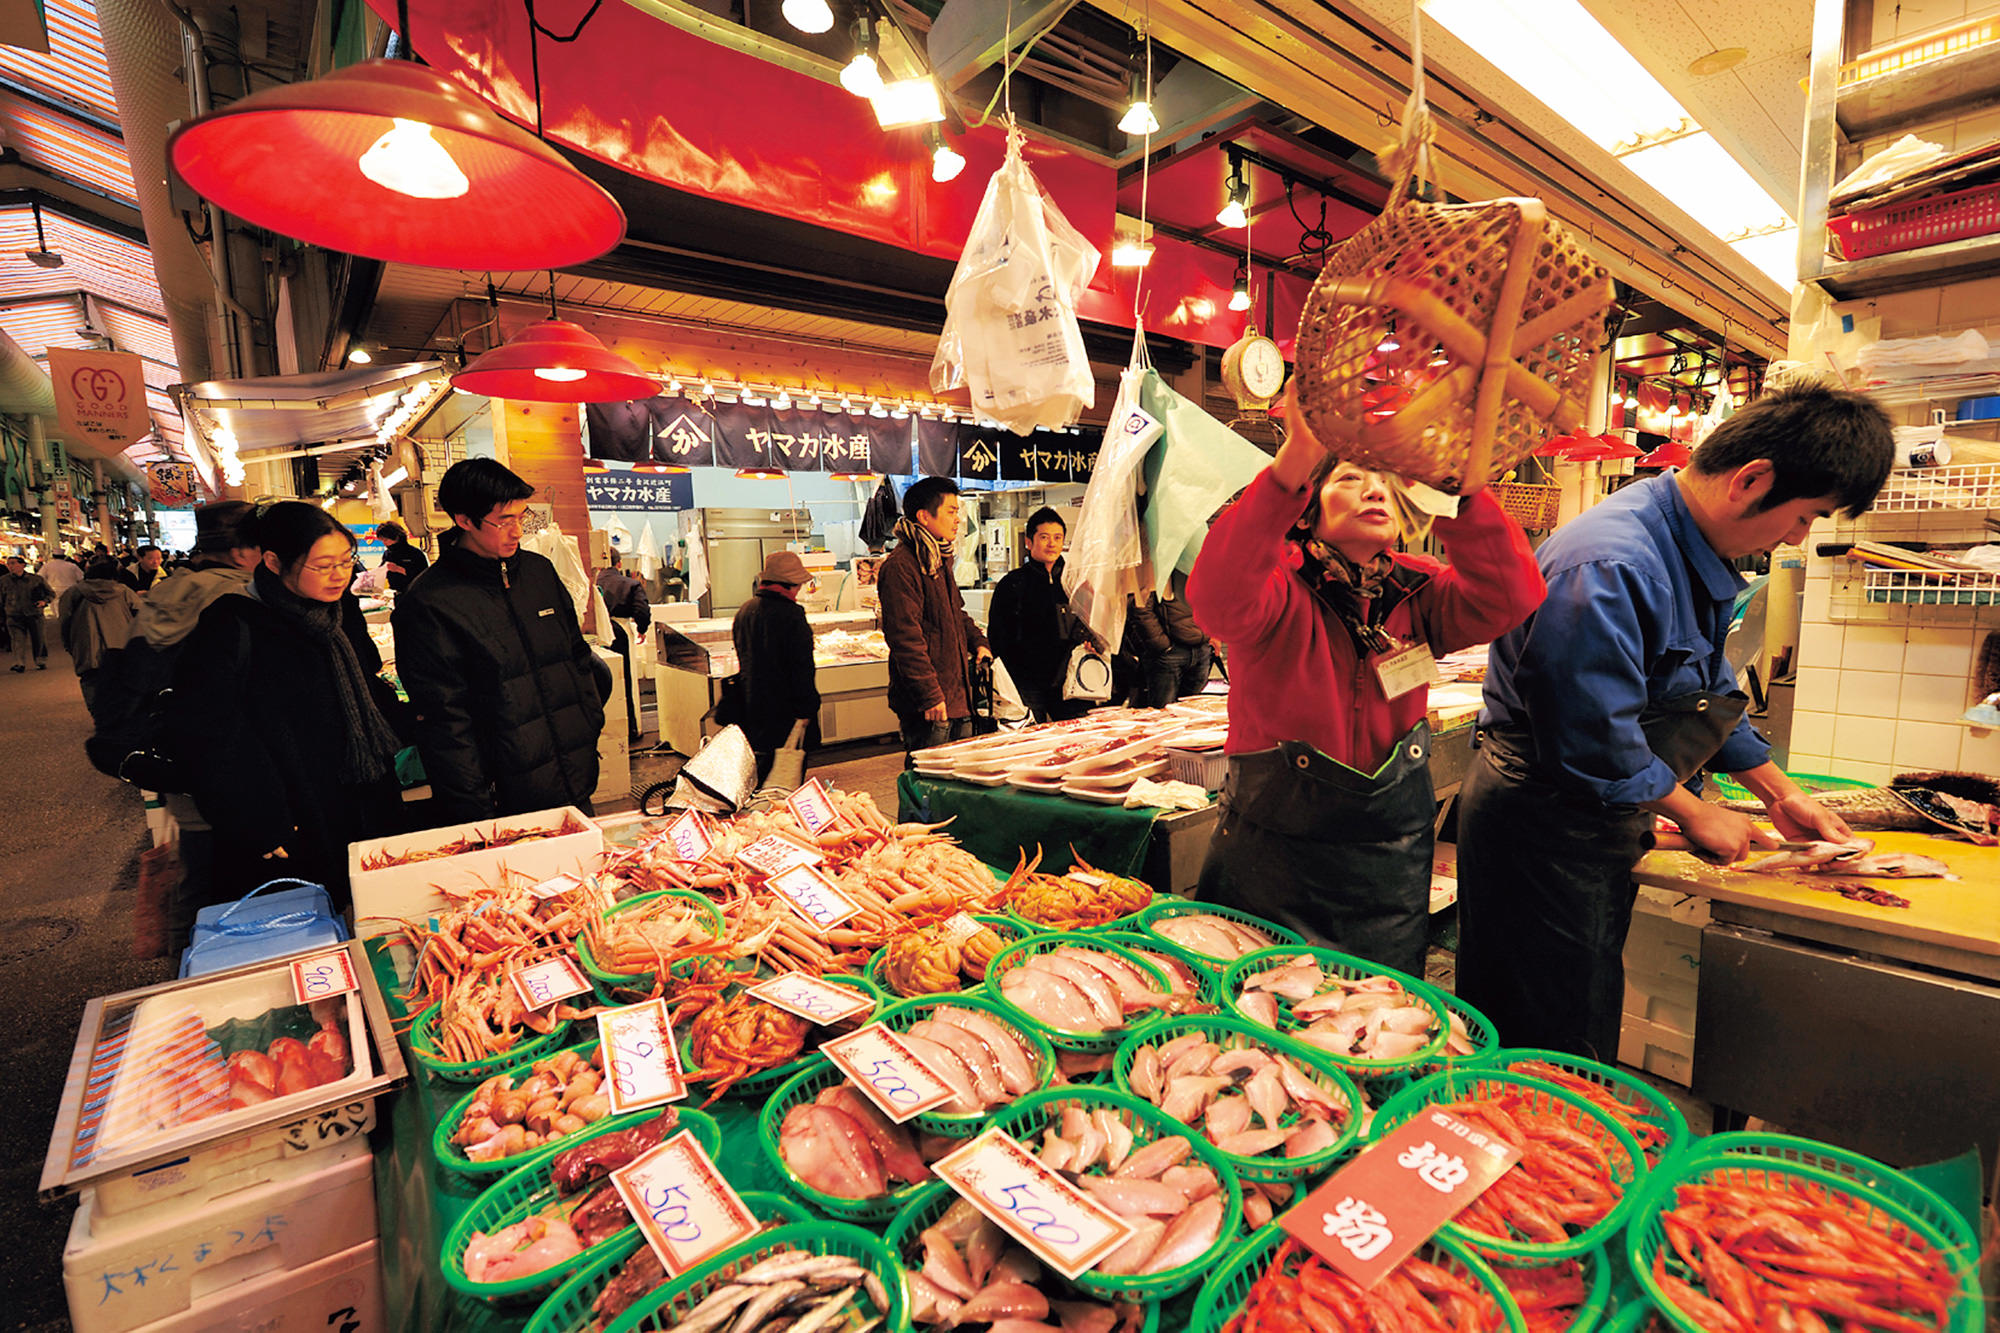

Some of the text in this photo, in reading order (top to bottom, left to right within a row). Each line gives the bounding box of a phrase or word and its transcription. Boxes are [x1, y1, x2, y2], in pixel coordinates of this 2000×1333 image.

[76, 409, 129, 419] MANNERS
[744, 427, 871, 461] ヤマカ水産
[586, 485, 672, 503] ヤマカ水産
[782, 881, 836, 924] 3500
[304, 965, 334, 994] 900
[608, 1040, 654, 1097] 900
[854, 1059, 921, 1104] 500
[644, 1183, 702, 1243] 500
[982, 1183, 1081, 1245] 500
